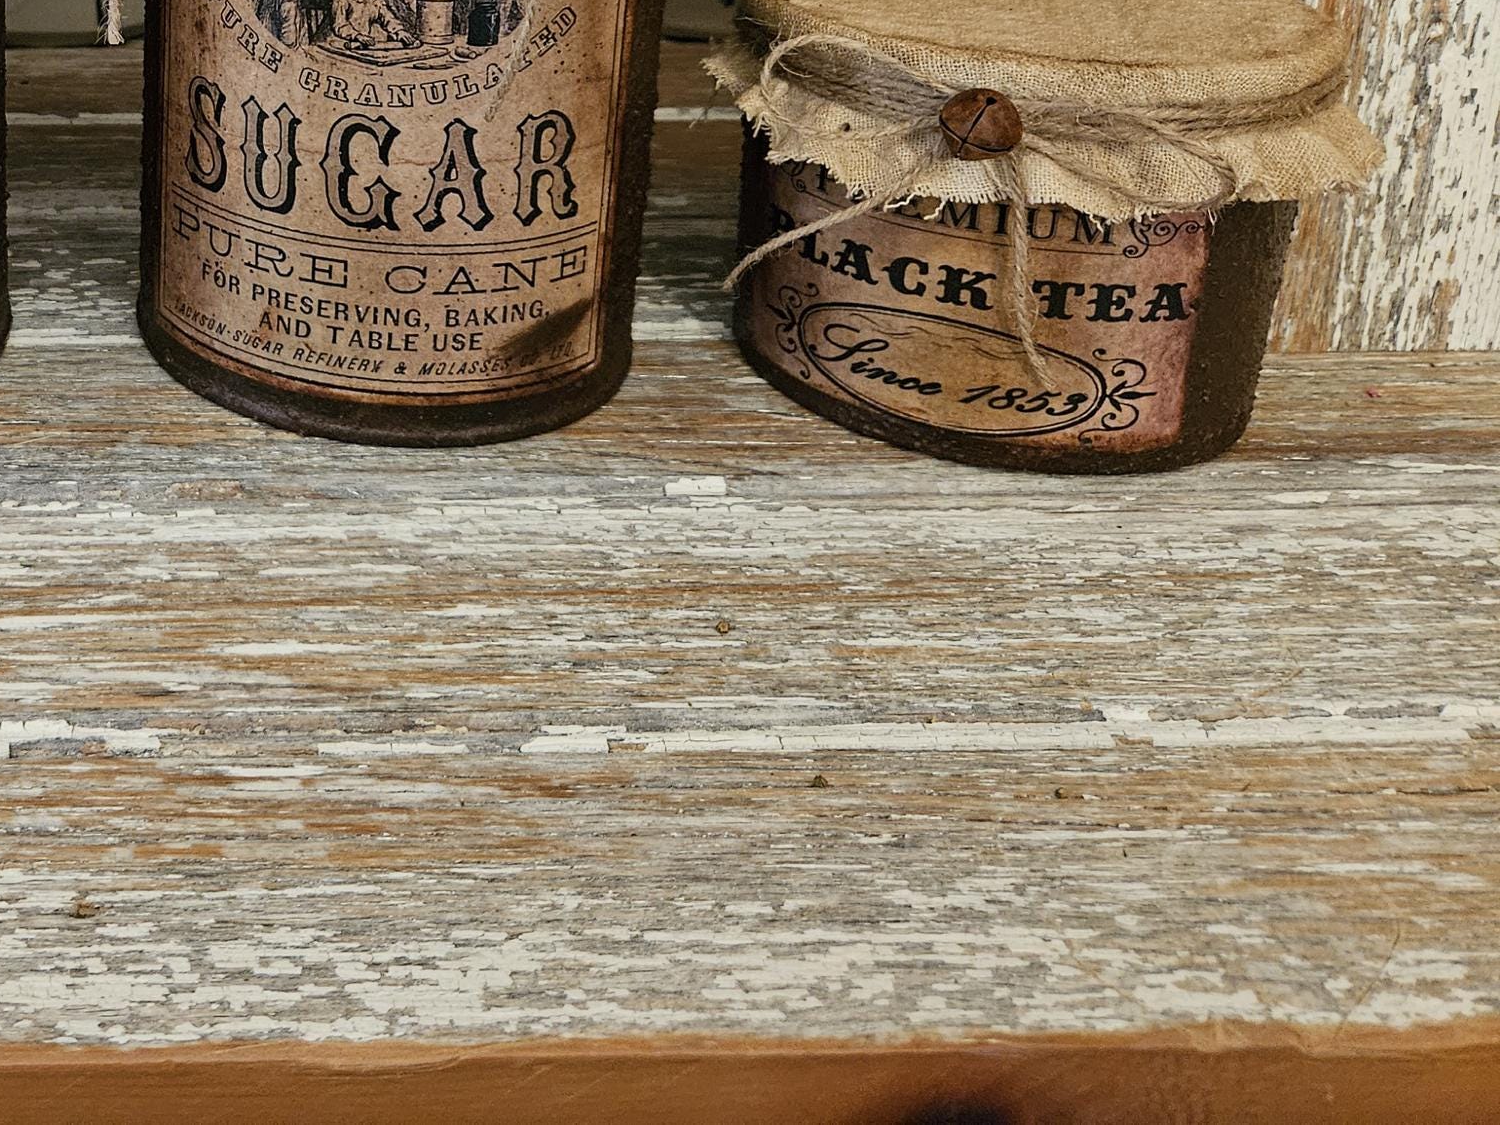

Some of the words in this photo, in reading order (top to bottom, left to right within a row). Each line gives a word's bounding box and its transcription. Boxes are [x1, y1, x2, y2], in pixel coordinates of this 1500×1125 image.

[185, 75, 579, 232] SUGAR
[172, 201, 349, 290] PURE
[385, 245, 588, 296] CANE
[201, 262, 241, 295] FOR
[251, 283, 430, 332] PRESERVING,
[445, 299, 550, 326] BAKING,
[258, 311, 312, 339] AND
[326, 326, 419, 352] TABLE
[432, 332, 484, 353] USE
[1032, 280, 1192, 324] TEA
[394, 362, 407, 375] &
[808, 323, 943, 397] Since
[957, 386, 1089, 423] 1853
